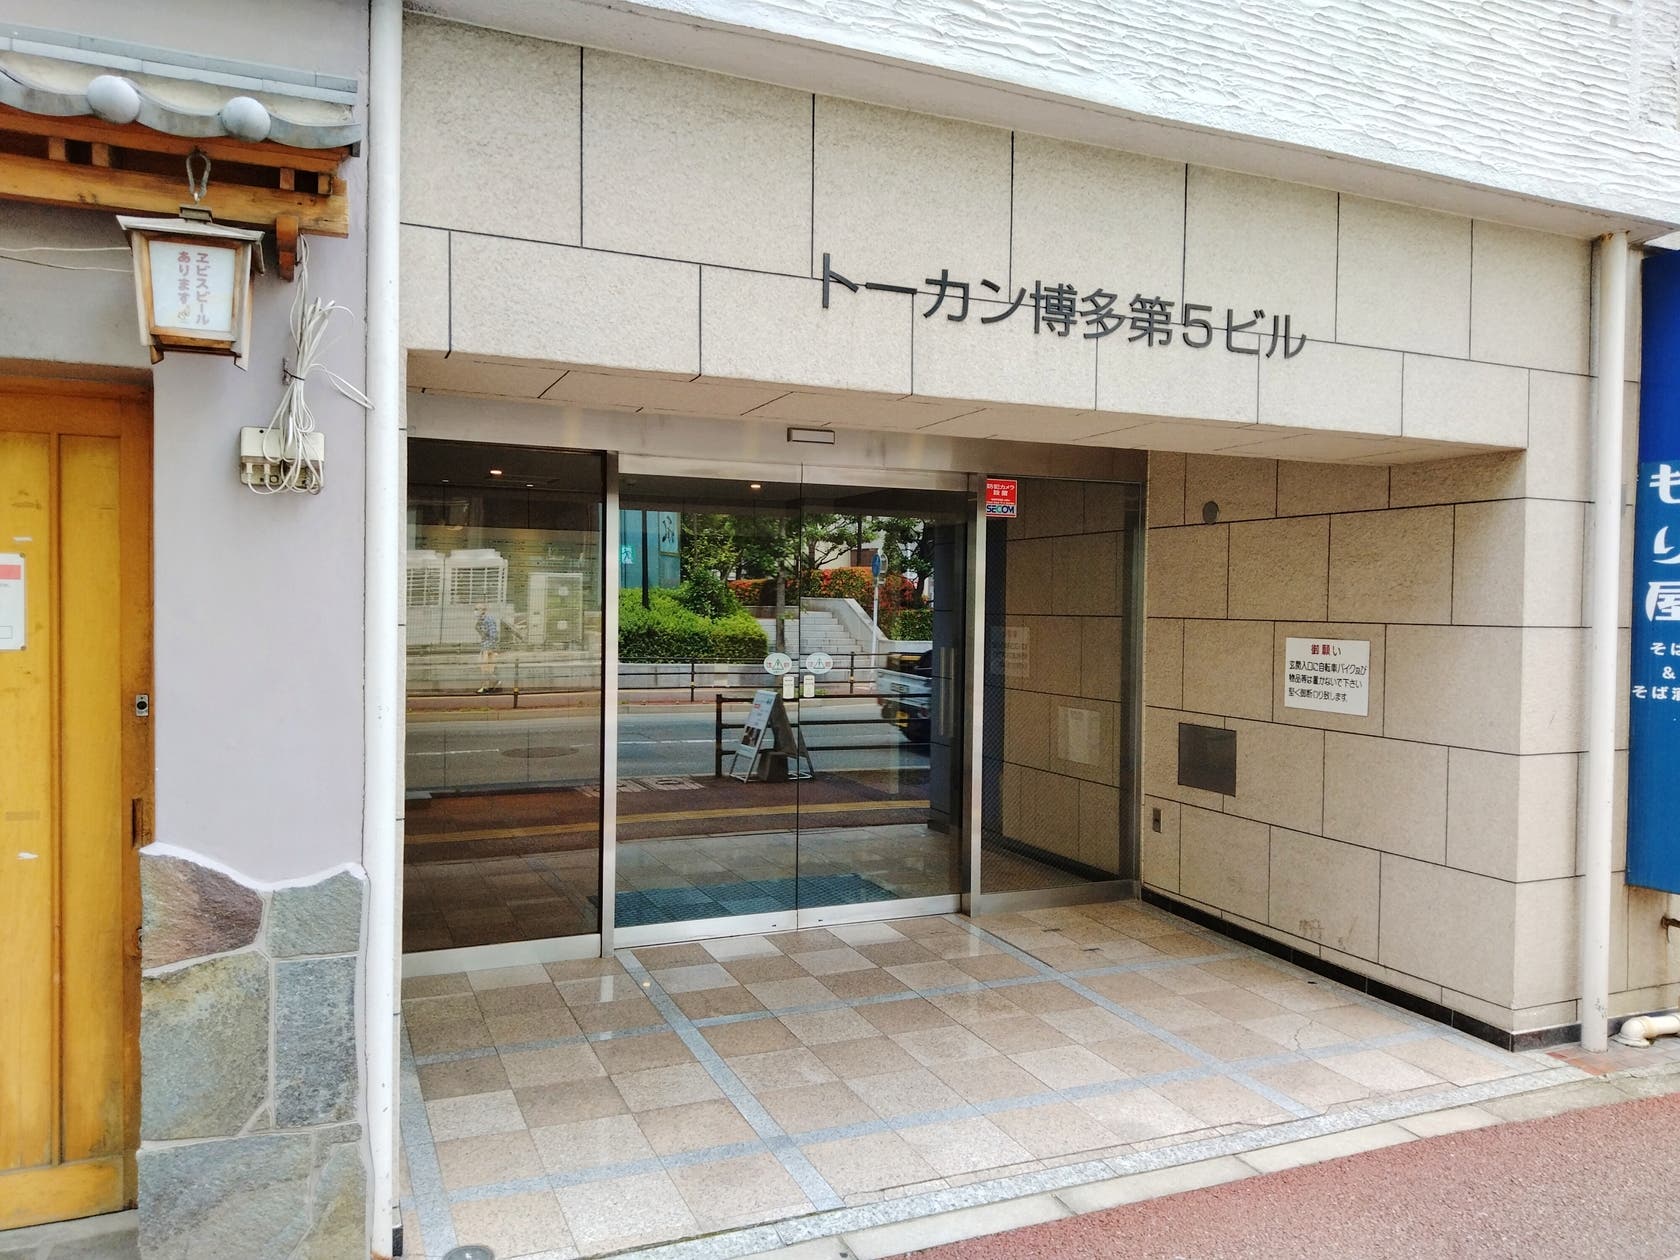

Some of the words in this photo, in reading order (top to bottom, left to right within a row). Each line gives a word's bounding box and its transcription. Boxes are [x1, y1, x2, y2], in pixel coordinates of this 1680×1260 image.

[177, 250, 191, 305] あります
[822, 252, 1307, 359] トーカン博多第5ビル
[986, 505, 1014, 513] SECOM
[1311, 644, 1341, 656] 御願い
[1662, 666, 1676, 680] &
